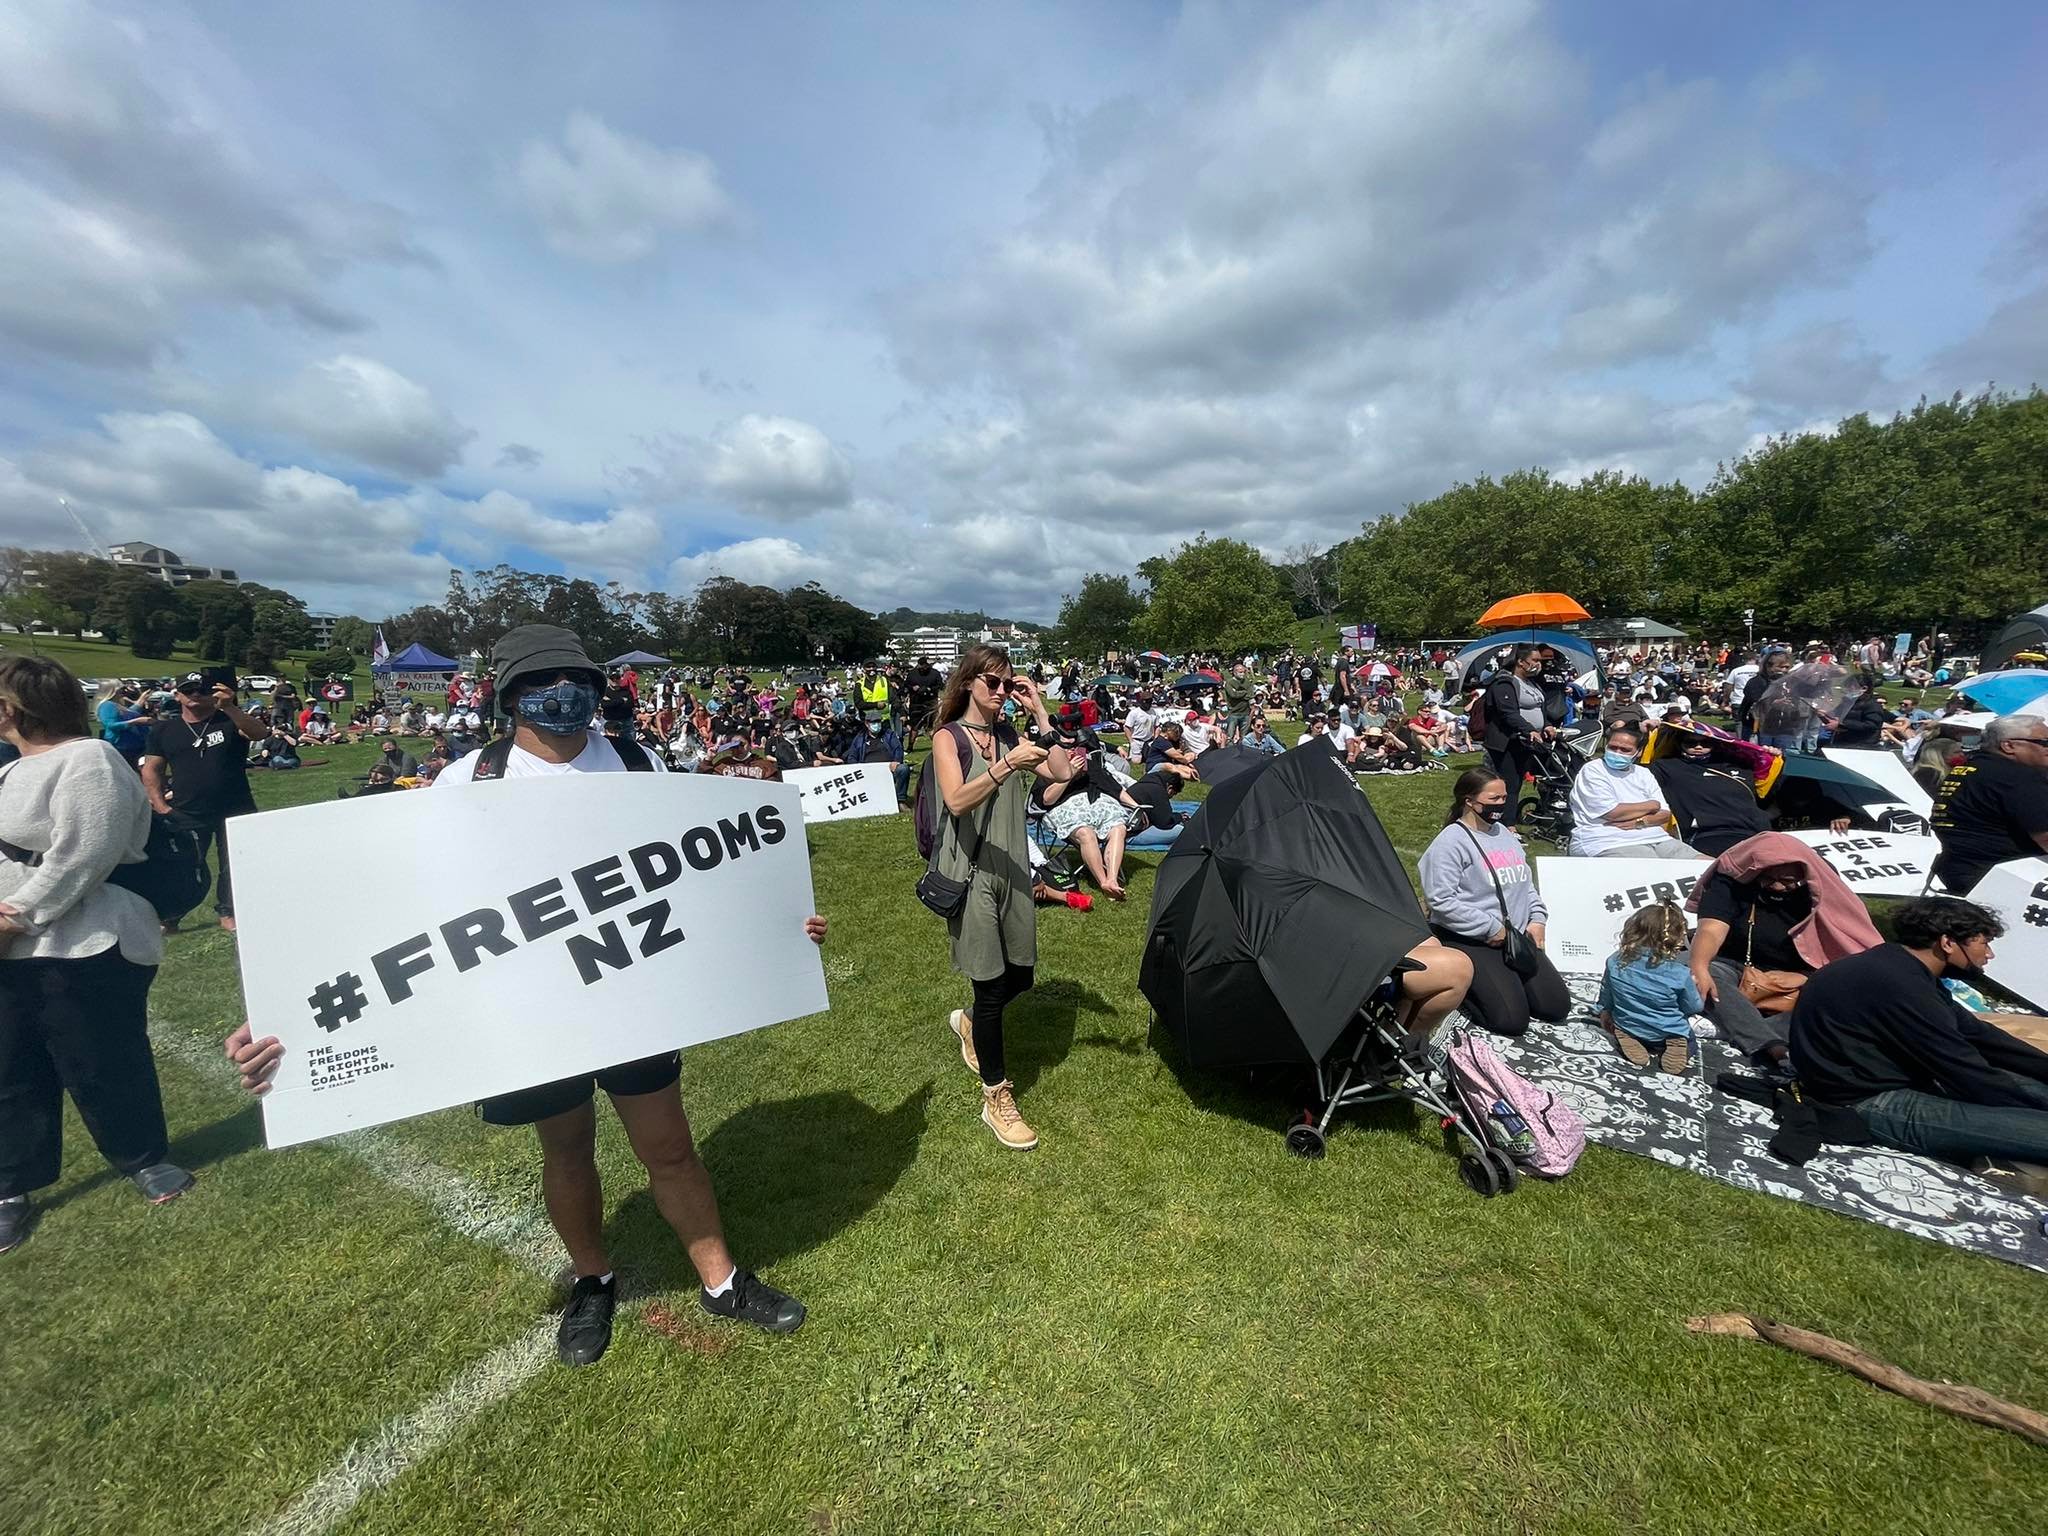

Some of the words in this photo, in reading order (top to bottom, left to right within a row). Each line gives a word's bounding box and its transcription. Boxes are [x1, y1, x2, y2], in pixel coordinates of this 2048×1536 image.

[813, 769, 865, 796] #FREE
[838, 787, 850, 798] 2
[827, 792, 869, 815] LIVE
[1847, 853, 1871, 866] 2
[1840, 862, 1923, 882] RADE
[1603, 875, 1698, 913] #FRE
[308, 805, 786, 1032] #FREEDOMS
[565, 898, 686, 985] NZ
[307, 1045, 334, 1058] THE
[309, 1045, 378, 1068] FREEDOMS
[310, 1068, 319, 1077] &
[327, 1055, 379, 1073] RIGHTS
[311, 1062, 395, 1087] COALITION.
